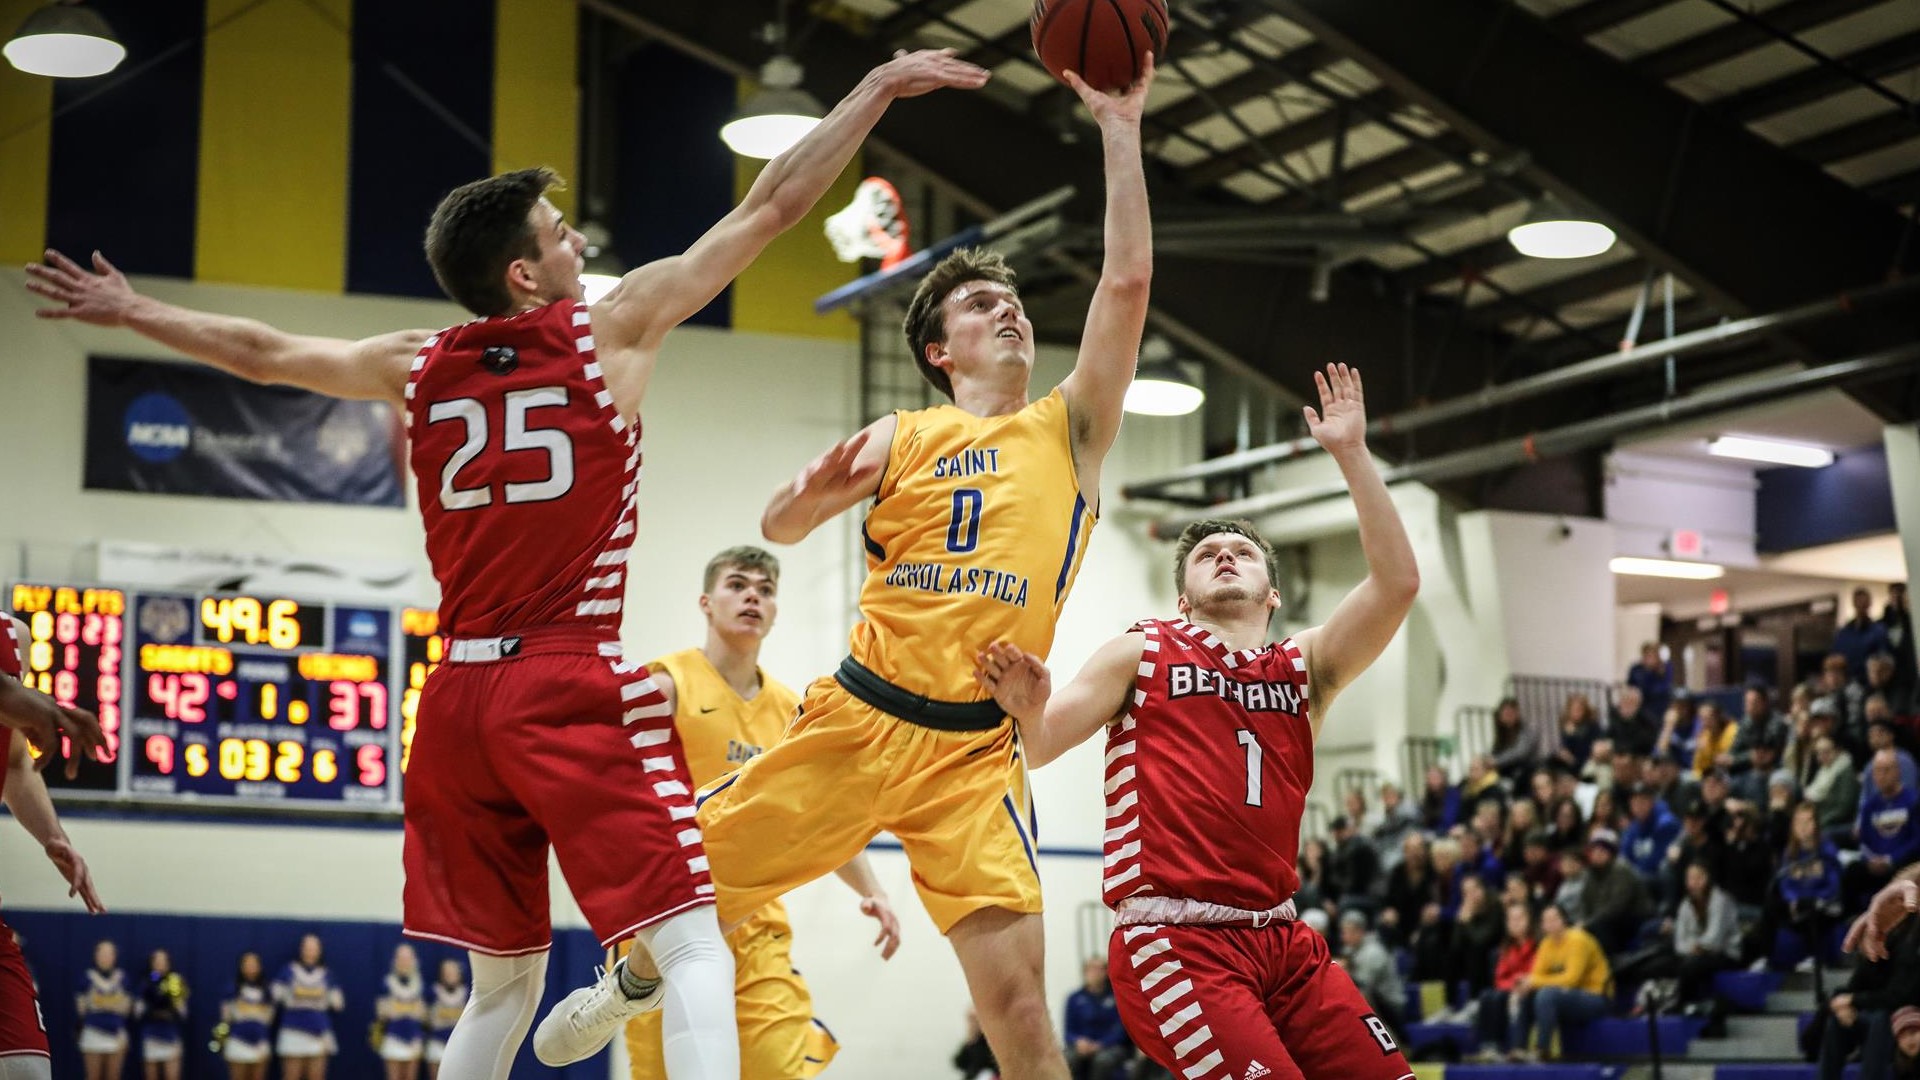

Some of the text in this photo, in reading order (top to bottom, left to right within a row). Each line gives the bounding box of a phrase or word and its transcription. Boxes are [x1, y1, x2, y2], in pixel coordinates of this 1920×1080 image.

[428, 386, 574, 512] 25
[934, 448, 999, 479] SAINT
[946, 487, 984, 553] 0
[885, 562, 1029, 609] SCHOLASTICA
[201, 597, 301, 649] 49.6
[149, 673, 210, 722] 42
[329, 680, 388, 730] 37
[1168, 663, 1301, 717] BETHANY
[145, 734, 175, 775] 9
[357, 744, 386, 786] 5
[1235, 729, 1264, 808] 1
[1362, 1014, 1399, 1055] B
